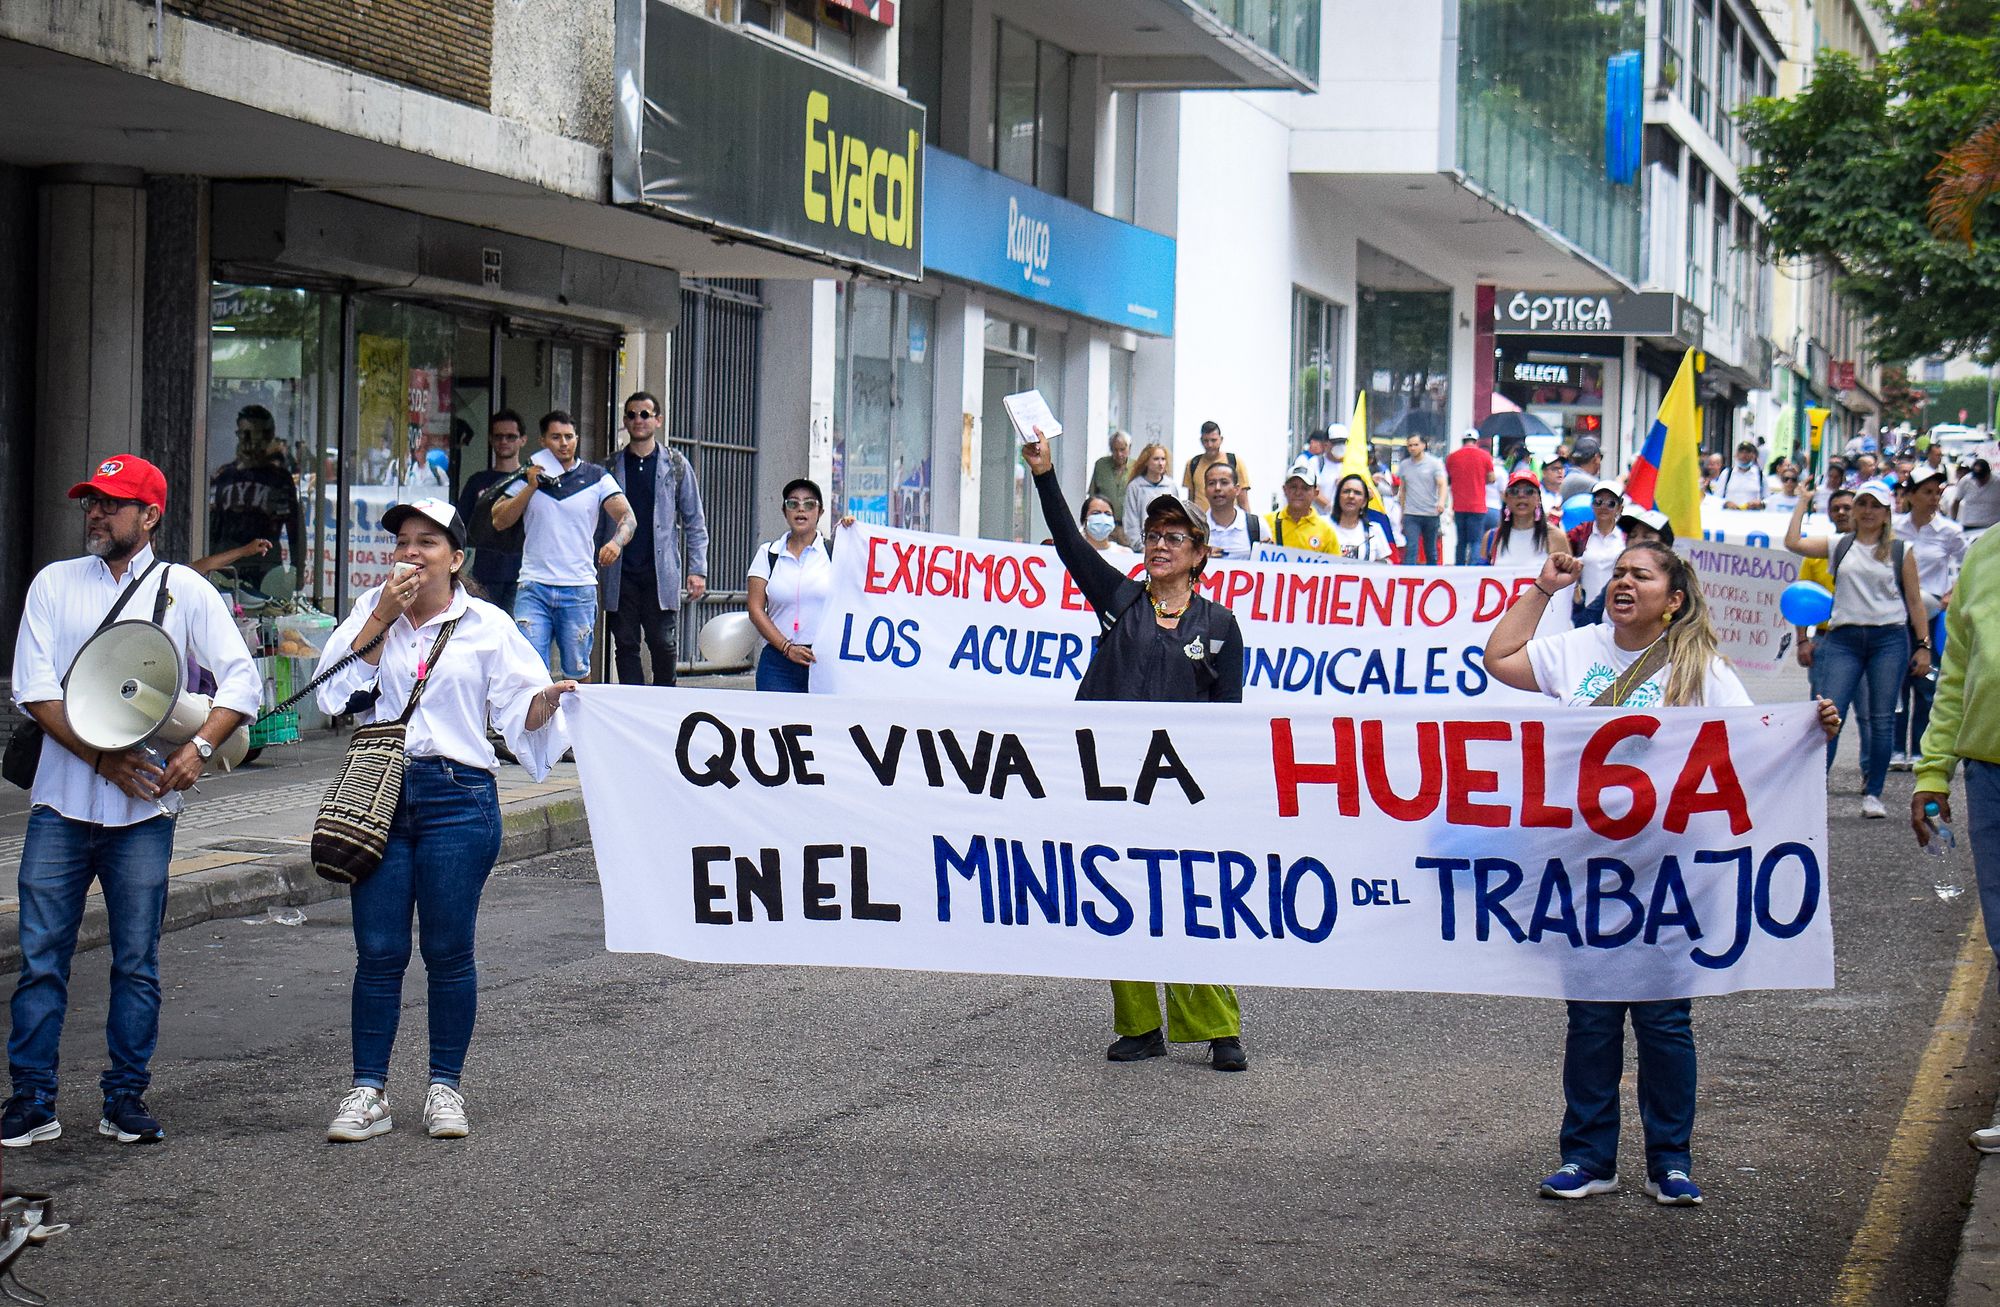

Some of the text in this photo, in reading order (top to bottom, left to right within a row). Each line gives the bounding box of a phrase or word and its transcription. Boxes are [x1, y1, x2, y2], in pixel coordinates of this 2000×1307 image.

[804, 90, 916, 250] Evacol
[1006, 196, 1050, 281] Rayco
[1551, 320, 1613, 331] SELECTA
[1514, 362, 1569, 384] SELECTA
[864, 536, 1047, 610] EXIGIMOS
[1060, 568, 1097, 613] E
[1127, 562, 1457, 627] MPLIMIENTO
[1689, 549, 1799, 583] MINTRABAJO
[839, 612, 1489, 698] LOS ACUER INDICALES
[1749, 629, 1768, 647] NO
[675, 711, 825, 789] QUE
[848, 724, 1046, 800] VIVA
[1075, 728, 1206, 805] LA
[691, 834, 1820, 969] EN EL MINISTERIO DEL TRABAJO
